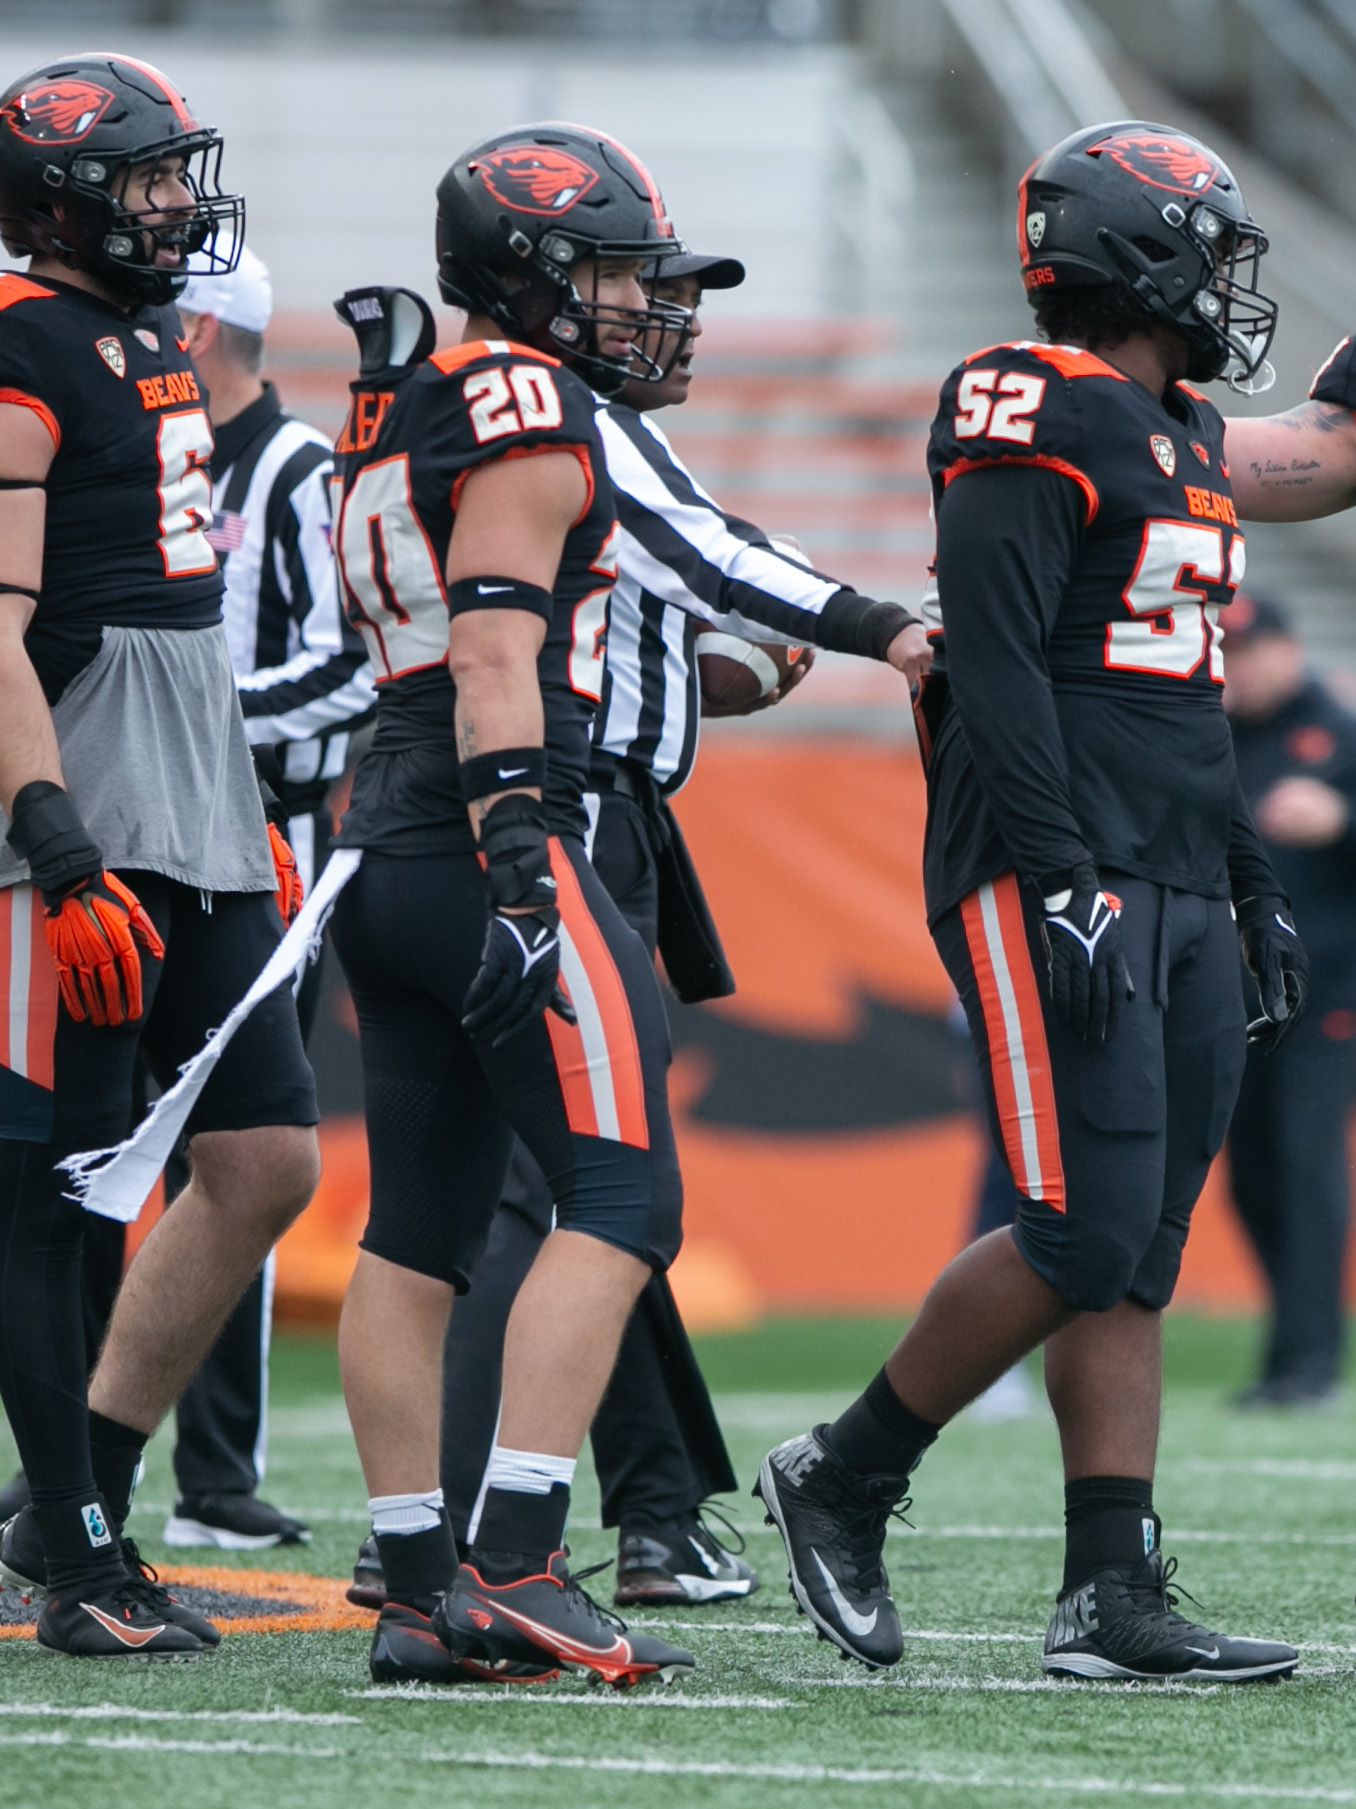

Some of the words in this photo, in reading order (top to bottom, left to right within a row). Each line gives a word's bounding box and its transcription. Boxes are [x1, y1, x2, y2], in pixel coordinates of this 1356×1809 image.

[135, 371, 200, 410] BEAVS
[463, 364, 564, 445] 20
[954, 369, 1047, 446] 52
[155, 407, 217, 578] 6
[1184, 484, 1239, 528] BEAVS
